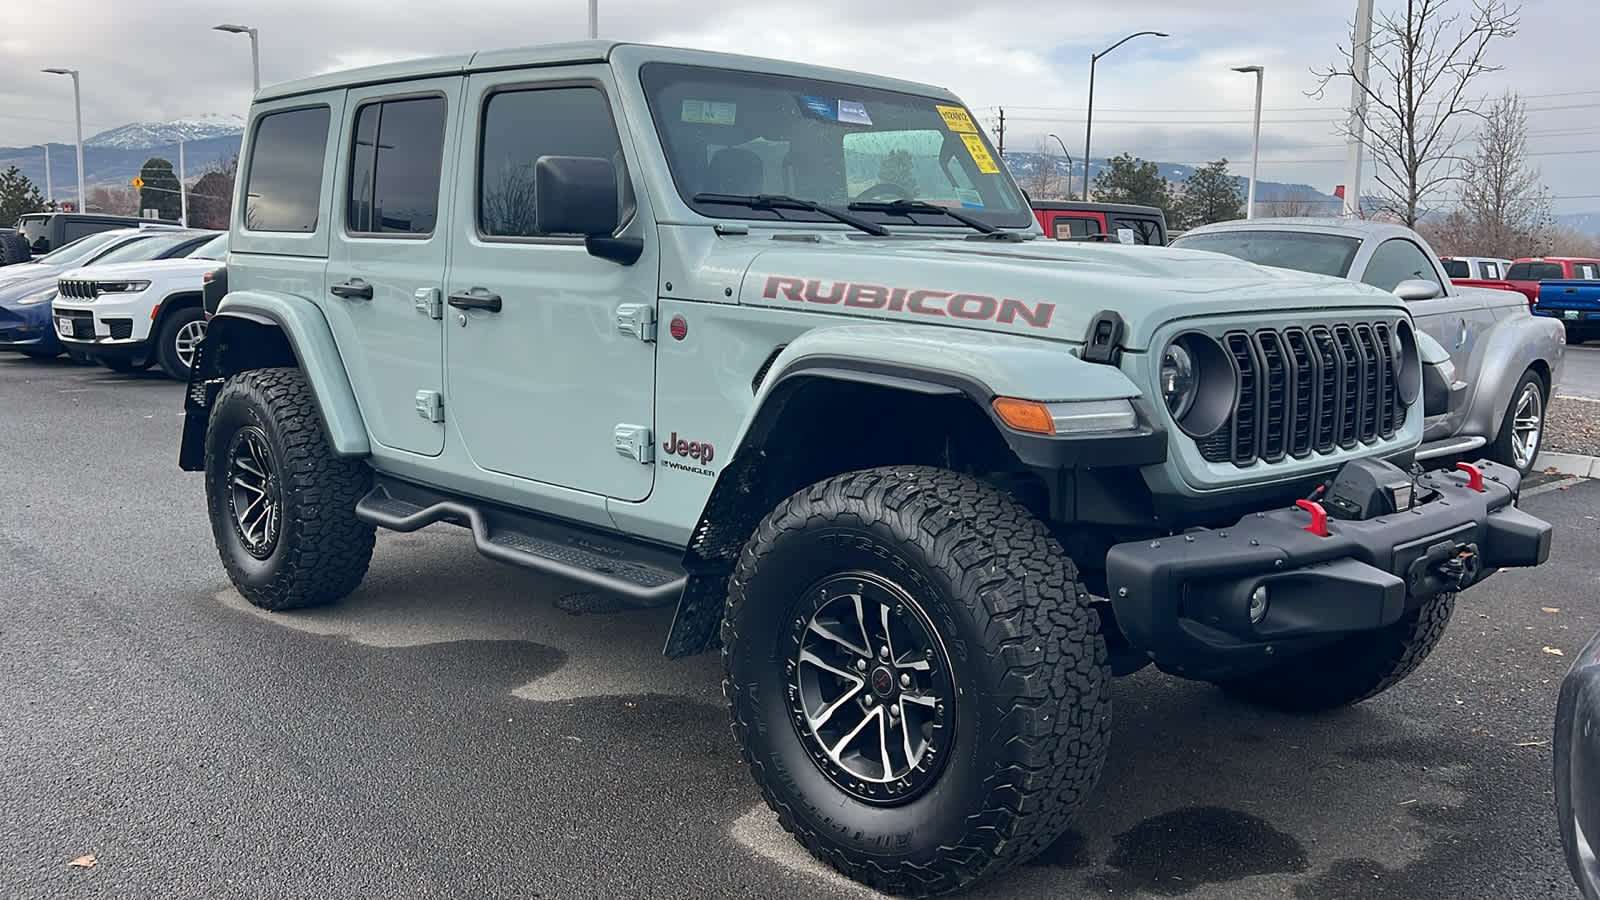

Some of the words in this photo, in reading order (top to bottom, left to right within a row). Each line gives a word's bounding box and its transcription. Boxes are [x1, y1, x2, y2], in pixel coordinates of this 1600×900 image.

[763, 276, 1056, 328] RUBICON
[663, 431, 714, 466] Jeep
[669, 460, 715, 477] WRANGLER
